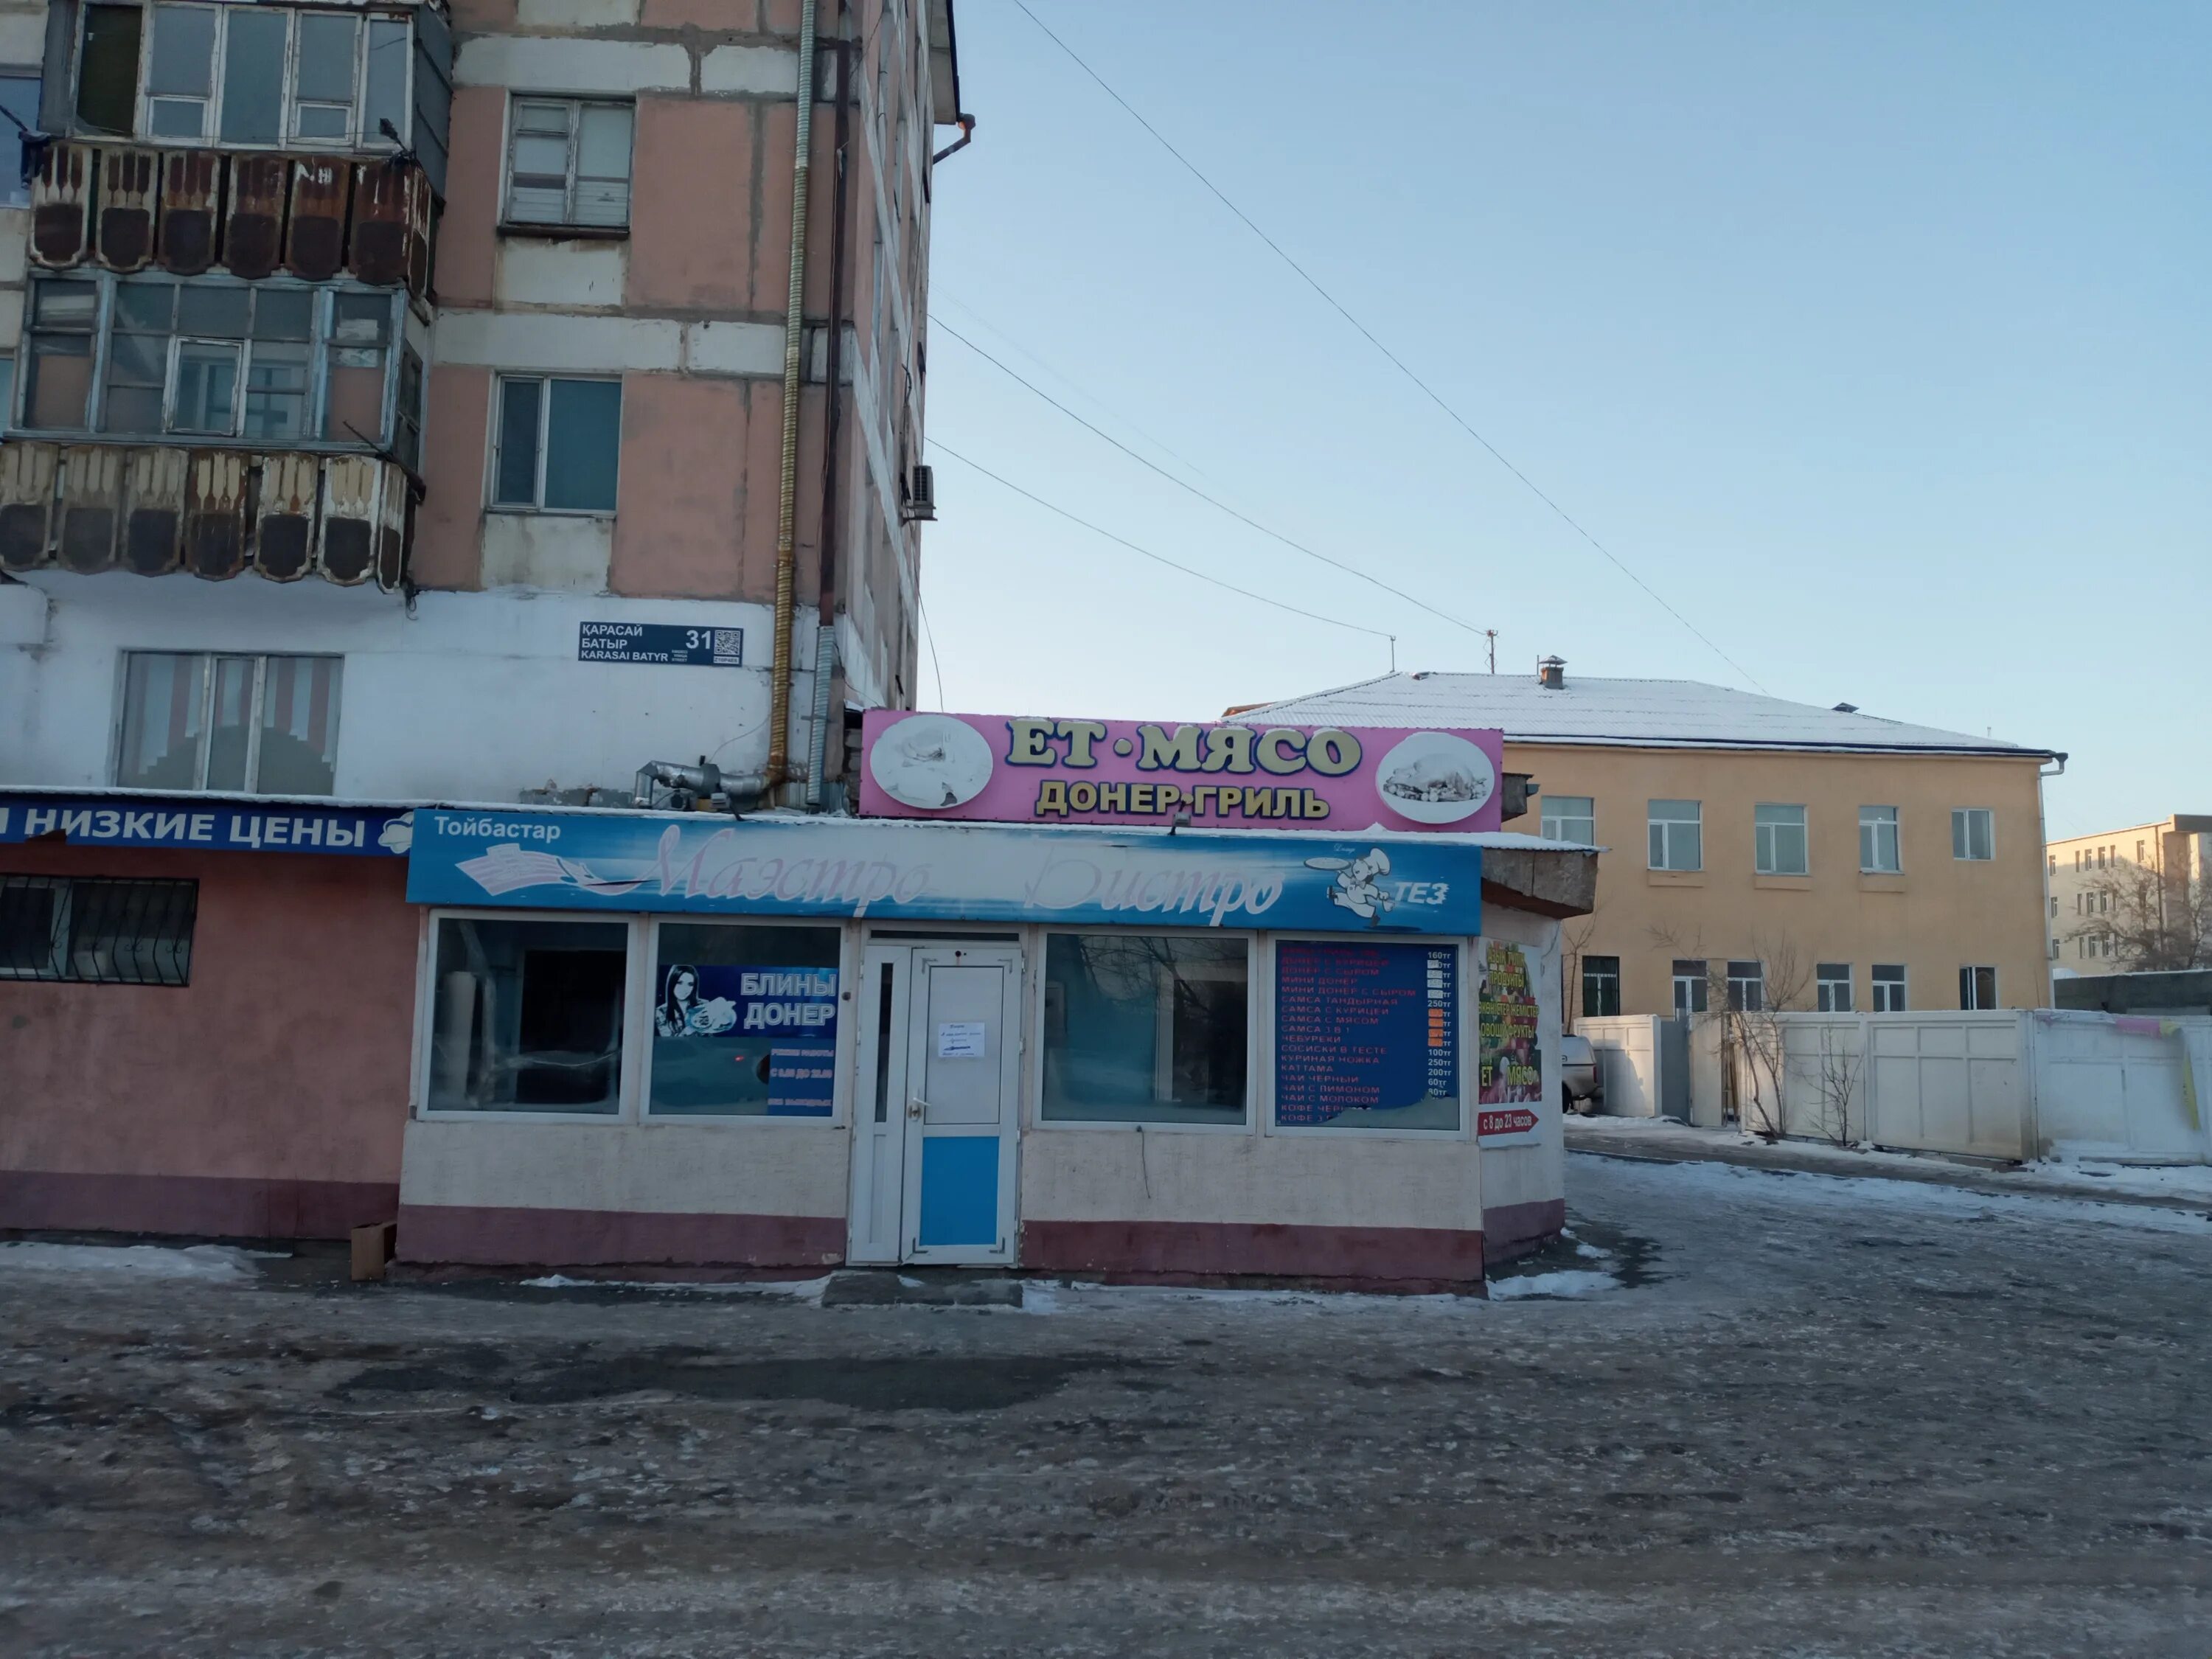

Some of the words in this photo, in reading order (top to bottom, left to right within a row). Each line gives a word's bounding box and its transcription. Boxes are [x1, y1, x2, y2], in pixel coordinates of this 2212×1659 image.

[582, 624, 643, 637] ҚАРАСАЙ
[582, 638, 627, 649] БАТЫР
[686, 630, 712, 650] 31
[581, 650, 630, 660] KARASAI
[633, 653, 668, 661] BATYR
[1005, 717, 1107, 768] ЕТ
[1136, 724, 1362, 777] МЯСО
[1034, 779, 1181, 818] ДОНЕР
[1192, 785, 1330, 820] ГРИЛЬ
[24, 808, 215, 841] НИЗКИЕ
[229, 815, 365, 849] ЦЕНЫ
[434, 815, 561, 844] Тойбастар
[1394, 882, 1450, 905] ТЕЗ
[1427, 951, 1451, 959] 160тг
[740, 973, 837, 997] БЛИНЫ
[1489, 970, 1524, 988] ПРОДУКТЫ
[1326, 997, 1398, 1005] ТАНДЫРНАЯ
[1372, 988, 1416, 996] СЫРОМ
[744, 1002, 836, 1029] ДОНЕР
[1352, 1046, 1387, 1054] ТЕСТЕ
[1339, 1056, 1380, 1064] НОЖКА
[1427, 1058, 1451, 1066] 250тг
[1482, 1066, 1492, 1086] ЕТ
[1507, 1065, 1534, 1085] МЯСО
[1484, 1119, 1488, 1130] с
[1489, 1115, 1493, 1129] 8
[1495, 1117, 1503, 1130] до
[1505, 1113, 1512, 1128] 23
[1514, 1116, 1532, 1127] часов
